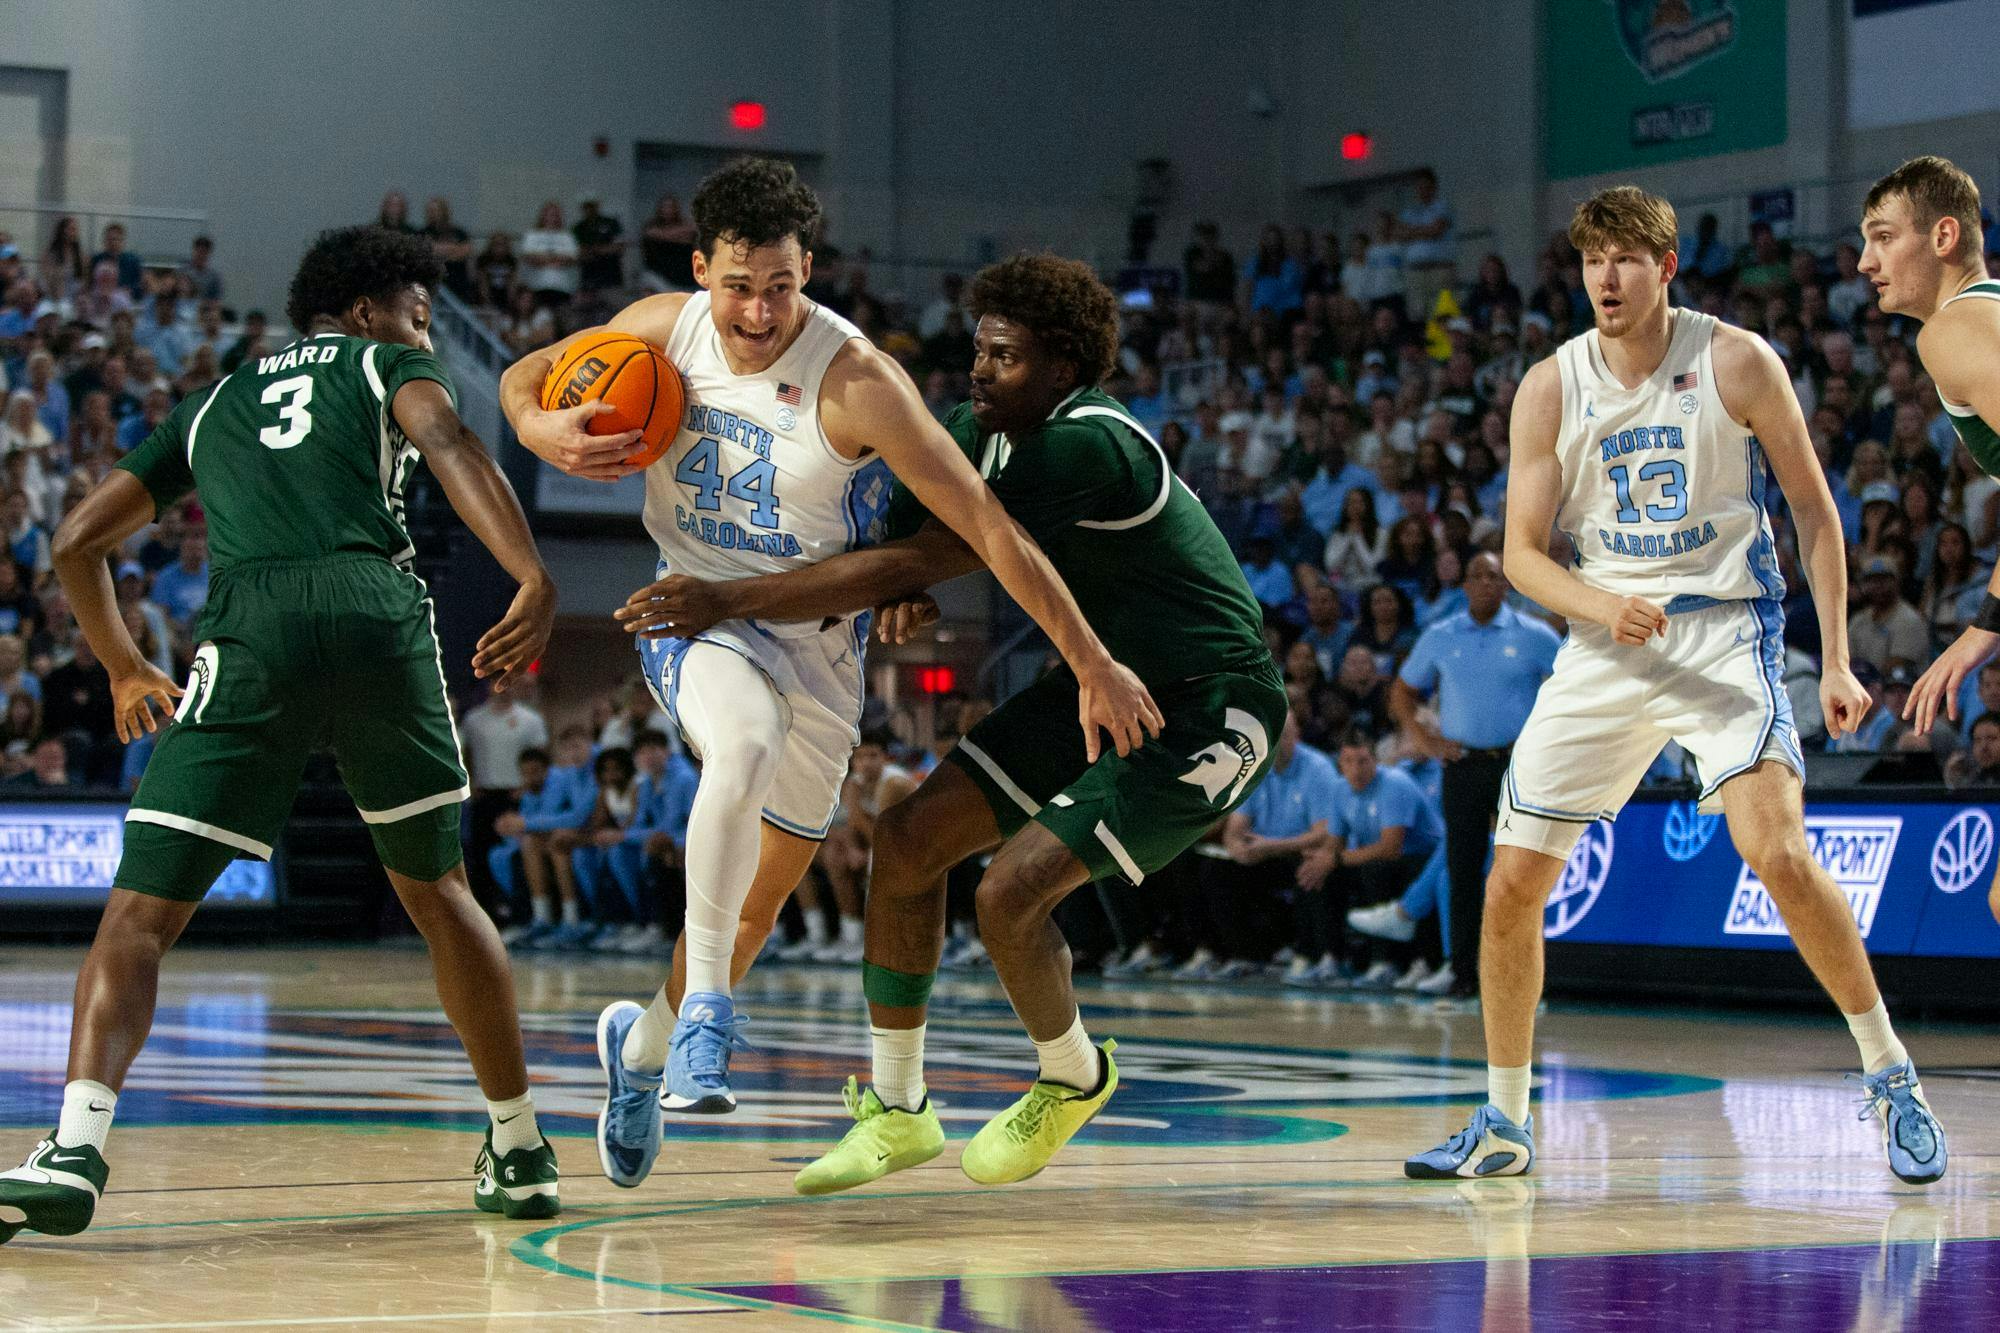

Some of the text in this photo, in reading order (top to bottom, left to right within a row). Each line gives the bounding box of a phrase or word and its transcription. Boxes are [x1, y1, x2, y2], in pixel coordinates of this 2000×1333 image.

[257, 345, 339, 375] WARD
[558, 357, 611, 409] Wils
[259, 374, 314, 450] 3
[688, 405, 774, 461] NORTH
[1600, 425, 1685, 462] NORTH
[675, 436, 780, 530] 44
[1608, 459, 1688, 523] 13
[675, 504, 803, 558] CAROLINA
[1599, 520, 1718, 558] CAROLINA
